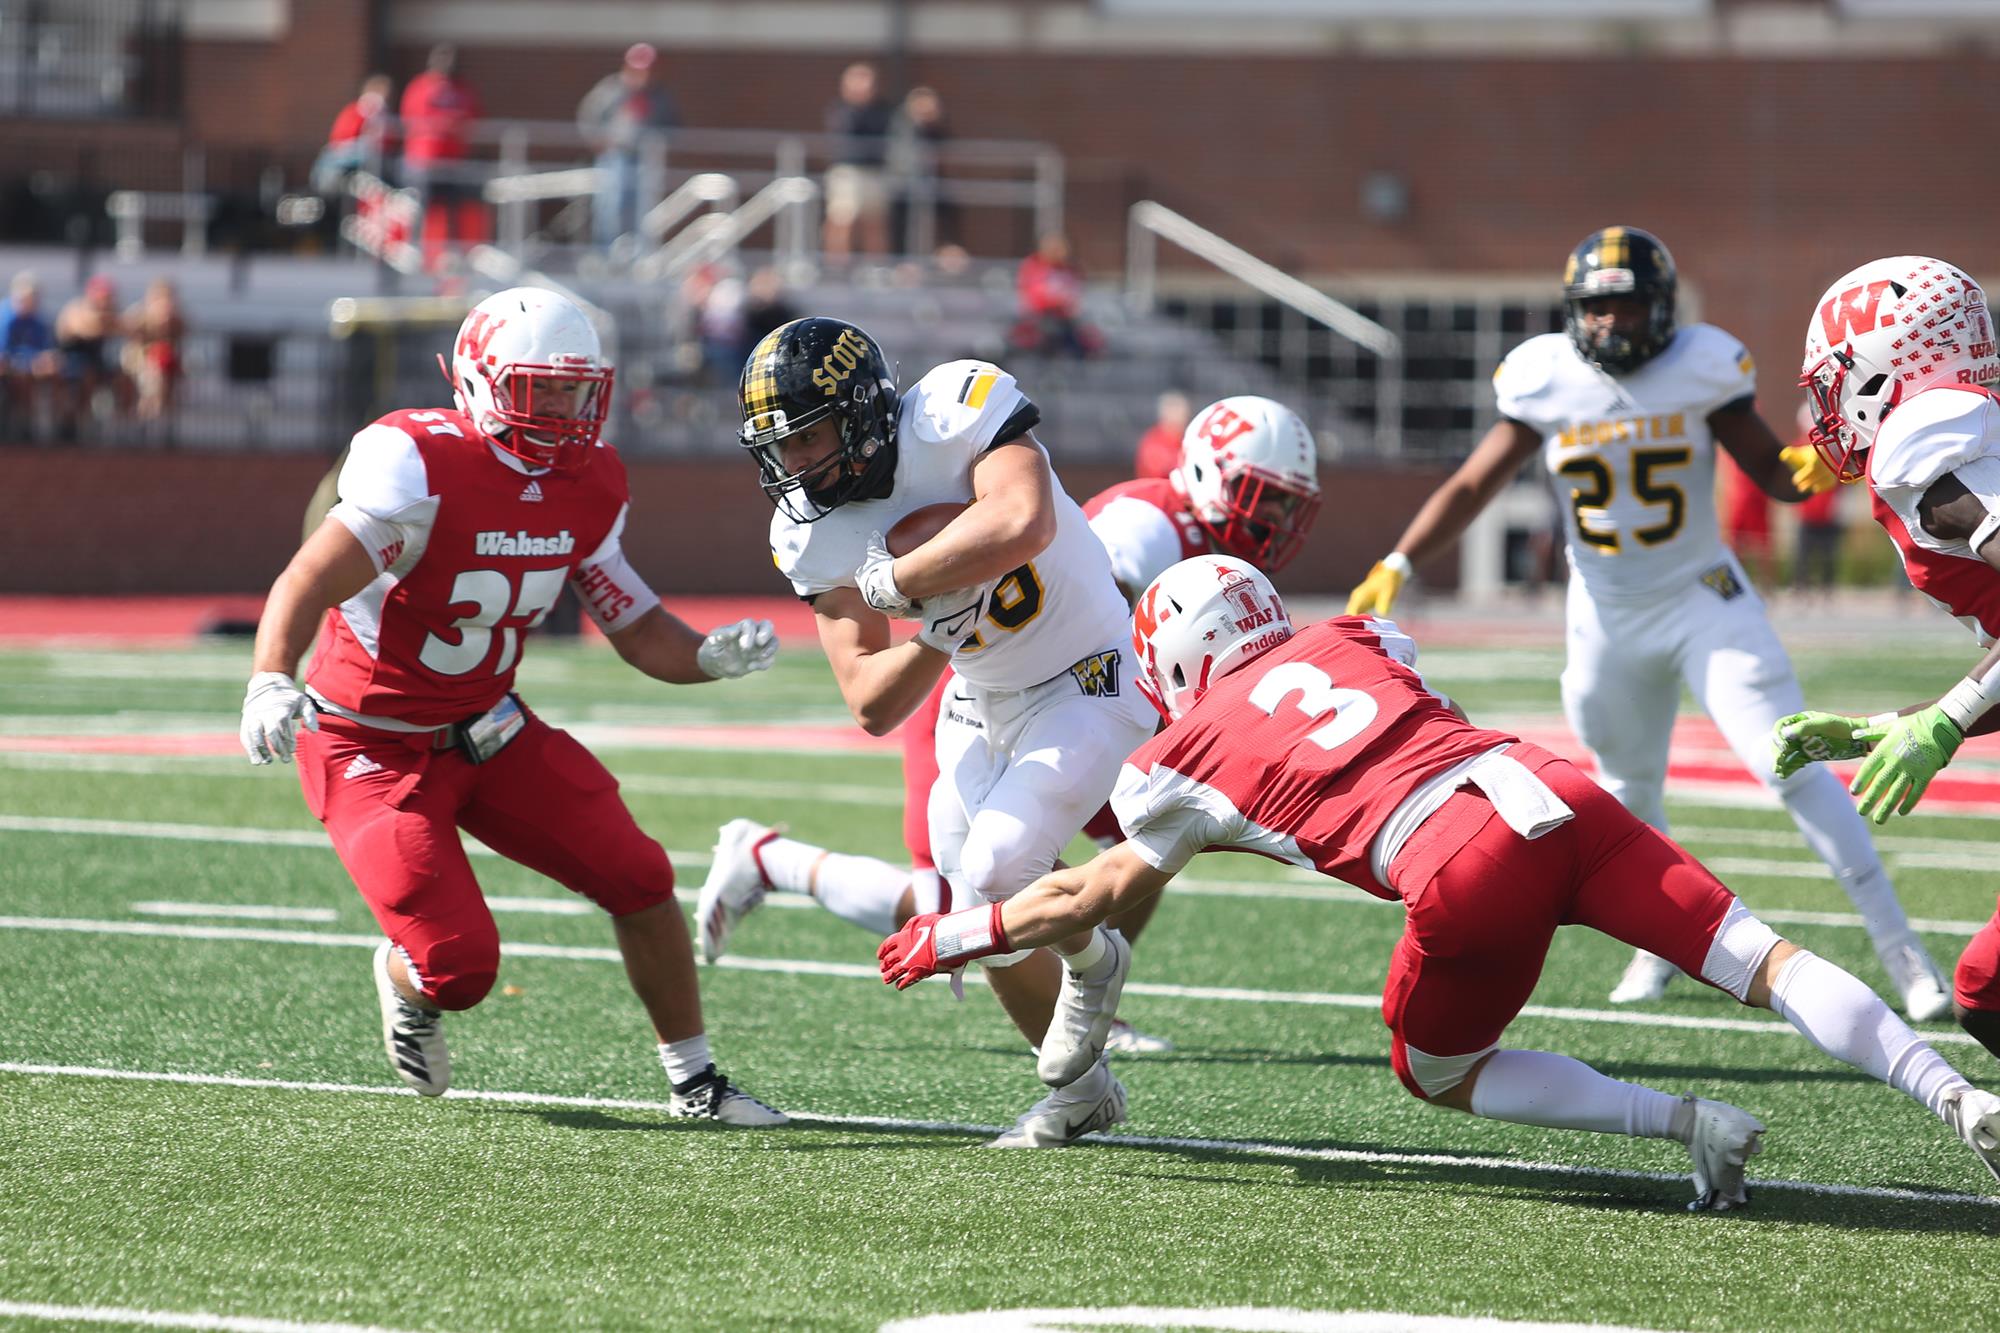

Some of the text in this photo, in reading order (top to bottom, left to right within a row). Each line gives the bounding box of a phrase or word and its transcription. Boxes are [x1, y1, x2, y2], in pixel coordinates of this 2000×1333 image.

[812, 329, 868, 395] SCOTS
[1957, 363, 2000, 384] Ridde
[1558, 446, 1693, 556] 25
[475, 530, 575, 556] Wabash
[418, 565, 570, 676] 37
[1235, 608, 1273, 633] WAF
[1241, 626, 1291, 655] Riddell
[1071, 648, 1121, 697] W
[1248, 661, 1379, 751] 3
